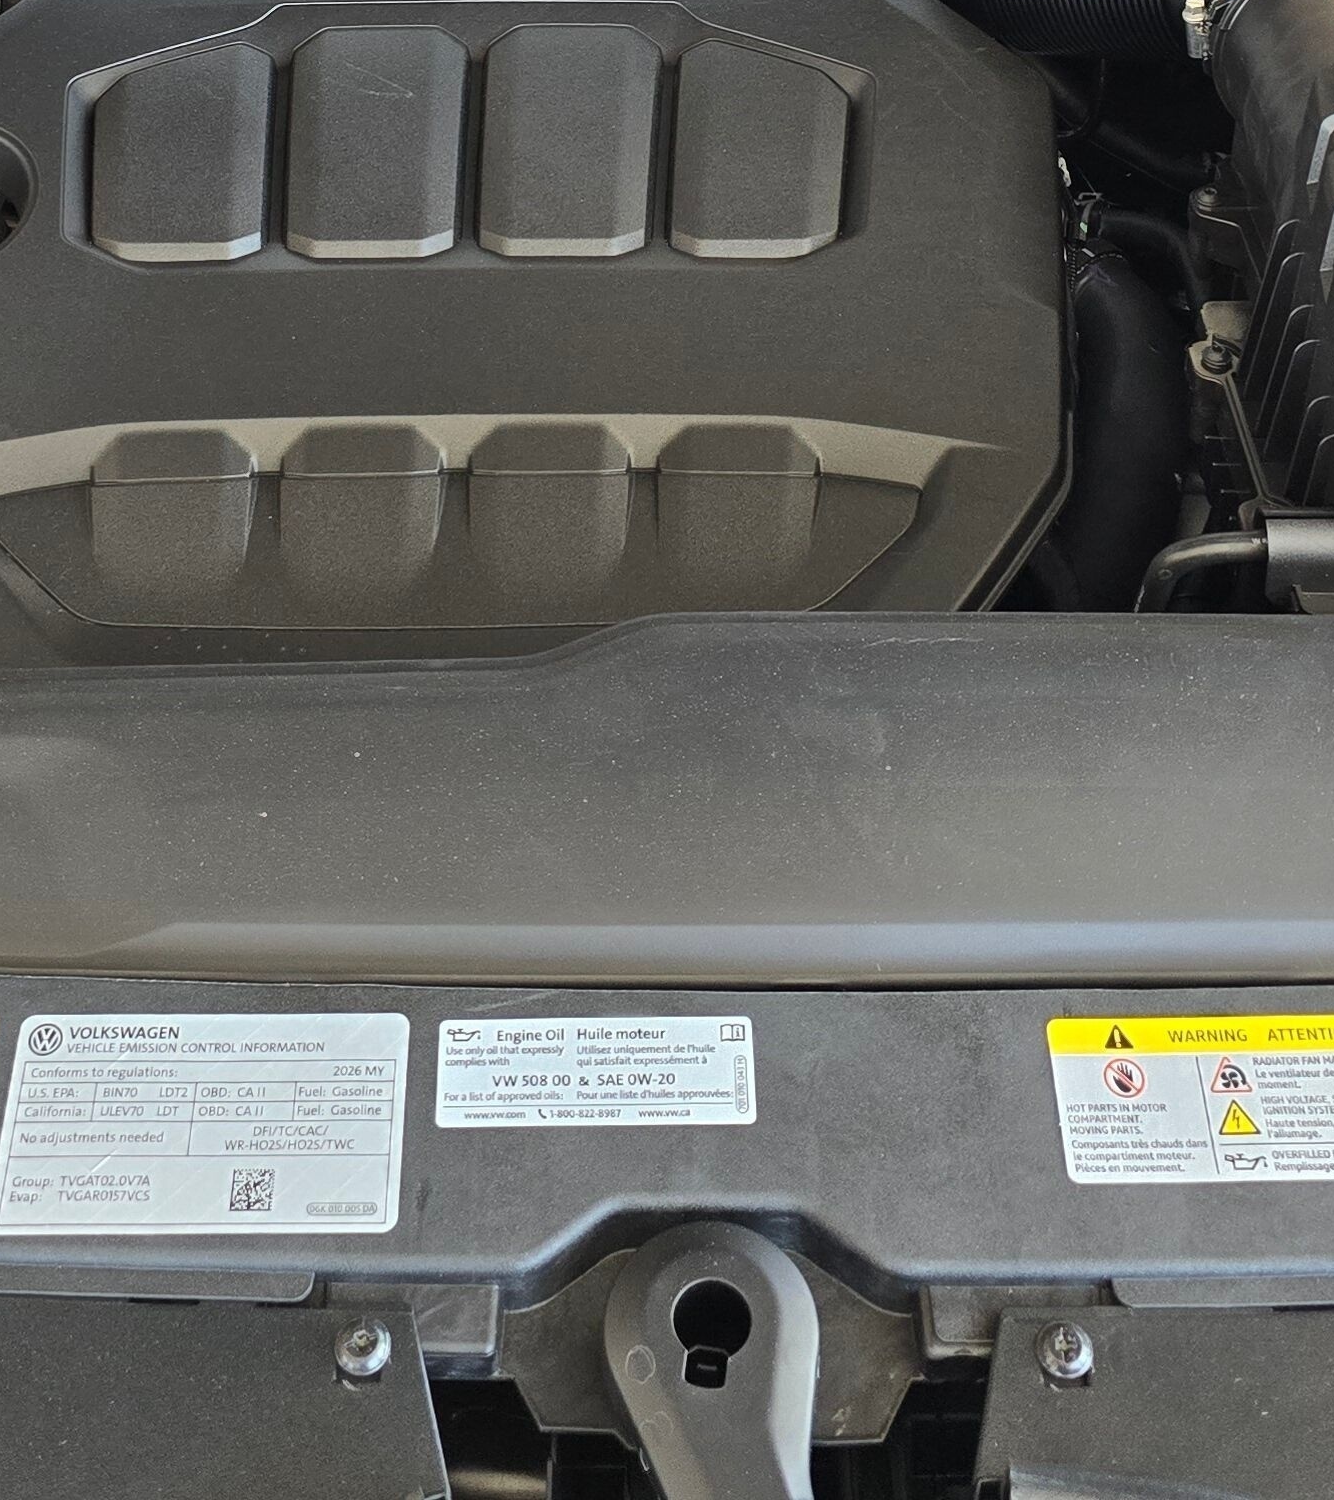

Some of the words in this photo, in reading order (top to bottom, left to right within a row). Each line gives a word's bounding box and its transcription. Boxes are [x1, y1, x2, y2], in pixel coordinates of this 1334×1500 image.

[70, 1027, 179, 1039] VOLKSWAGEN
[497, 1030, 542, 1044] Engine
[546, 1028, 564, 1040] Oil
[577, 1028, 612, 1040] Huile
[617, 1029, 666, 1039] moteur
[1168, 1030, 1247, 1042] WARNING
[67, 1043, 115, 1053] VEHICLE
[119, 1043, 177, 1052] EMISSION
[181, 1043, 236, 1052] CONTROL
[240, 1042, 325, 1052] INFORMATION
[446, 1047, 463, 1055] Use
[465, 1046, 485, 1057] only
[487, 1046, 498, 1054] oil
[500, 1046, 519, 1054] that
[521, 1045, 564, 1056] expressly
[577, 1045, 611, 1054] Utilisez
[614, 1046, 671, 1055] uniquement
[674, 1045, 685, 1053] de
[445, 1058, 487, 1068] complies
[489, 1058, 510, 1066] with
[577, 1057, 592, 1068] qui
[594, 1056, 631, 1065] satisfait
[634, 1055, 699, 1066] expressément
[1252, 1057, 1300, 1066] RADIATOR
[1302, 1056, 1321, 1064] FAN
[31, 1067, 88, 1078] Conforms
[92, 1068, 104, 1077] to
[107, 1066, 178, 1080] regulations:
[333, 1066, 361, 1076] 2026
[365, 1066, 385, 1076] MY
[1255, 1070, 1267, 1078] Le
[1269, 1069, 1320, 1078] ventilateur
[1323, 1068, 1334, 1076] de
[492, 1076, 518, 1086] VW
[522, 1075, 547, 1086] 508
[553, 1075, 571, 1086] 00
[579, 1077, 589, 1085] &
[598, 1074, 623, 1085] SAE
[628, 1073, 675, 1084] 0W-20
[28, 1088, 49, 1098] U.S.
[53, 1088, 79, 1098] EPA:
[103, 1088, 138, 1097] BIN70
[159, 1088, 188, 1097] LDT2
[201, 1088, 231, 1098] OBD:
[237, 1087, 254, 1097] CA
[298, 1087, 326, 1097] Fuel:
[332, 1086, 383, 1097] Gasoline
[444, 1092, 459, 1101] For
[469, 1092, 483, 1100] list
[486, 1092, 496, 1100] of
[497, 1091, 542, 1102] approved
[544, 1091, 563, 1100] oils:
[577, 1091, 598, 1099] Pour
[620, 1090, 638, 1099] liste
[1260, 1096, 1285, 1104] HIGH
[24, 1107, 86, 1117] California:
[100, 1106, 144, 1116] ULEV70
[157, 1106, 179, 1116] LDT
[198, 1106, 229, 1116] OBD:
[235, 1106, 252, 1116] CA
[297, 1106, 324, 1115] Fuel:
[331, 1105, 382, 1115] Gasoline
[550, 1110, 621, 1118] 1-800-822-8987
[639, 1109, 690, 1117] www.vw.ca
[1066, 1105, 1085, 1113] HOT
[1088, 1104, 1117, 1112] PARTS
[1119, 1104, 1130, 1112] IN
[1132, 1104, 1167, 1112] MOTOR
[1263, 1106, 1306, 1115] IGNITION
[1068, 1115, 1143, 1124] COMPARTMENT.
[1267, 1119, 1295, 1128] Haute
[253, 1125, 329, 1136] DFI/TC/CAC/
[1070, 1126, 1108, 1134] MOVING
[1111, 1126, 1143, 1134] PARTS.
[19, 1133, 36, 1143] No
[40, 1132, 116, 1146] adjustments
[119, 1132, 164, 1143] needed
[225, 1139, 355, 1150] WR-HO2S/HO2S/TWC
[1072, 1140, 1130, 1150] Composants
[1131, 1140, 1149, 1148] très
[1151, 1139, 1183, 1148] chauds
[1186, 1139, 1208, 1148] dans
[1074, 1152, 1082, 1160] le
[1085, 1152, 1154, 1161] compartiment
[1272, 1150, 1331, 1159] OVERFILLED
[1075, 1163, 1106, 1172] Pièces
[1123, 1164, 1185, 1172] mouvement.
[12, 1177, 53, 1188] Group:
[9, 1192, 42, 1204] Evap:
